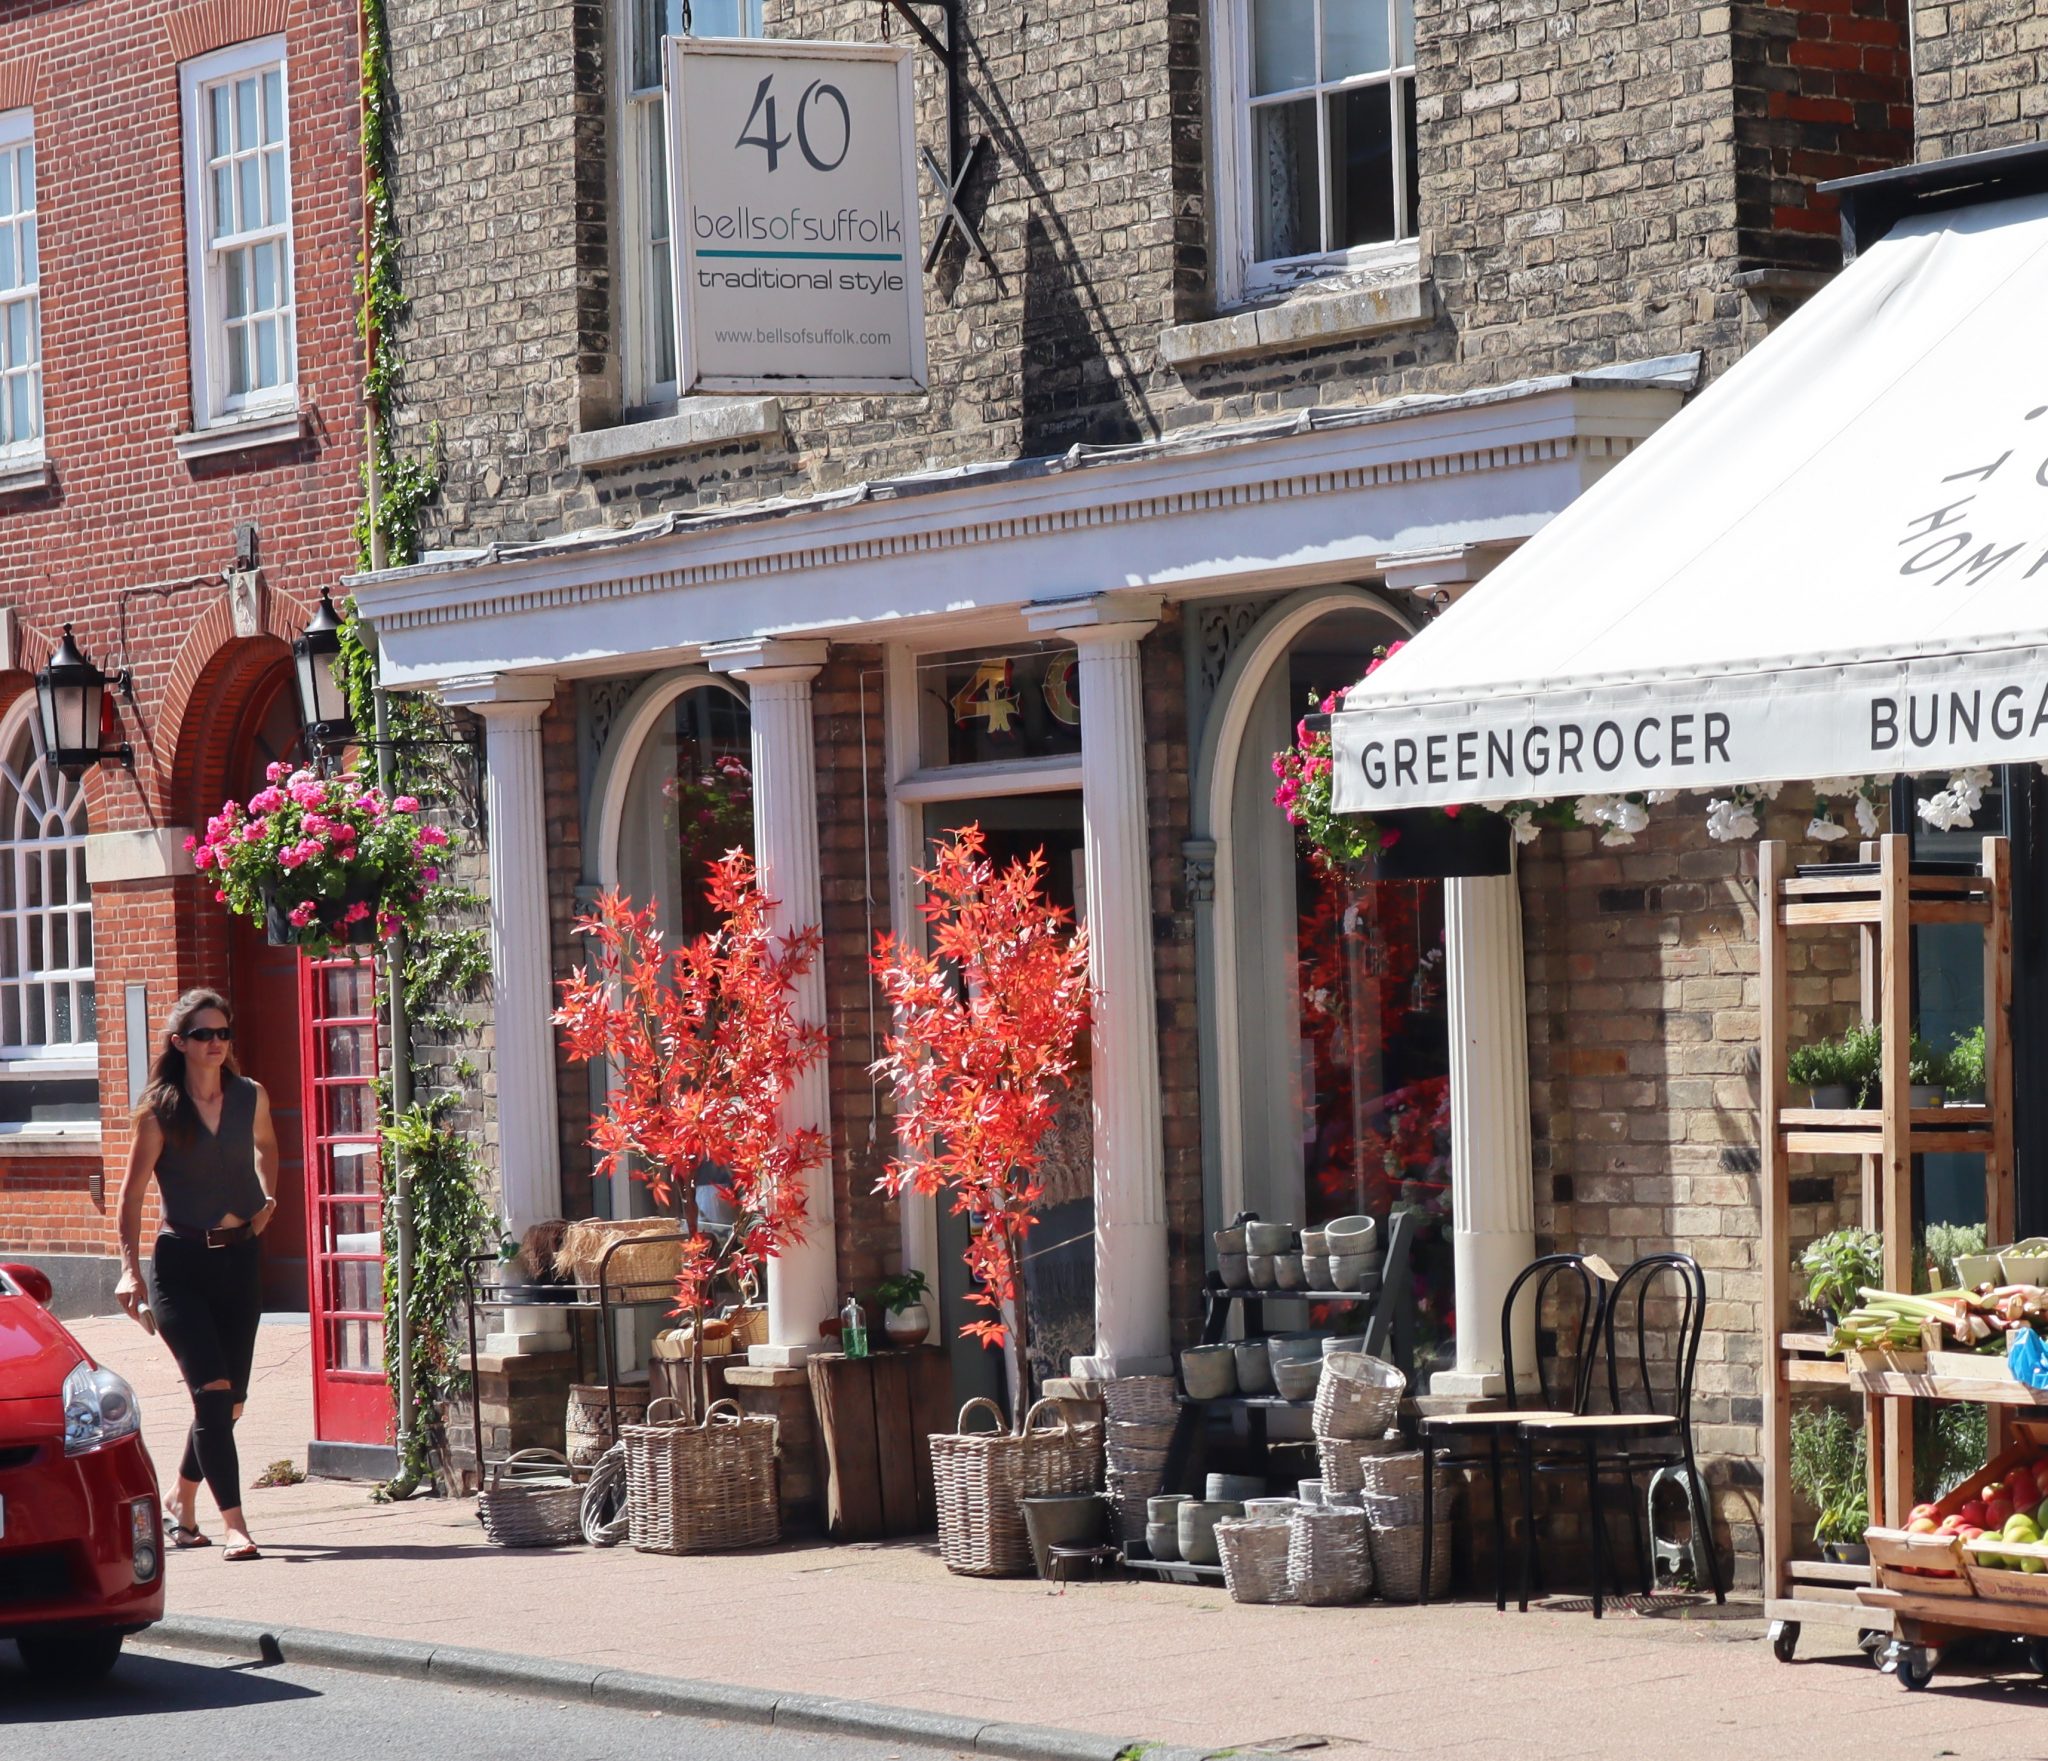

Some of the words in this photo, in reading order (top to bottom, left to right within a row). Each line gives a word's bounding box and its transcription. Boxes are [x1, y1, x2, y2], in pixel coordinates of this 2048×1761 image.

[735, 73, 850, 174] 40
[693, 206, 901, 243] bellsofsuffolk
[698, 268, 832, 290] traditional
[839, 270, 904, 295] style
[715, 327, 891, 345] www.bellsofsuffolk.com
[1361, 712, 1731, 789] GREENGROCER
